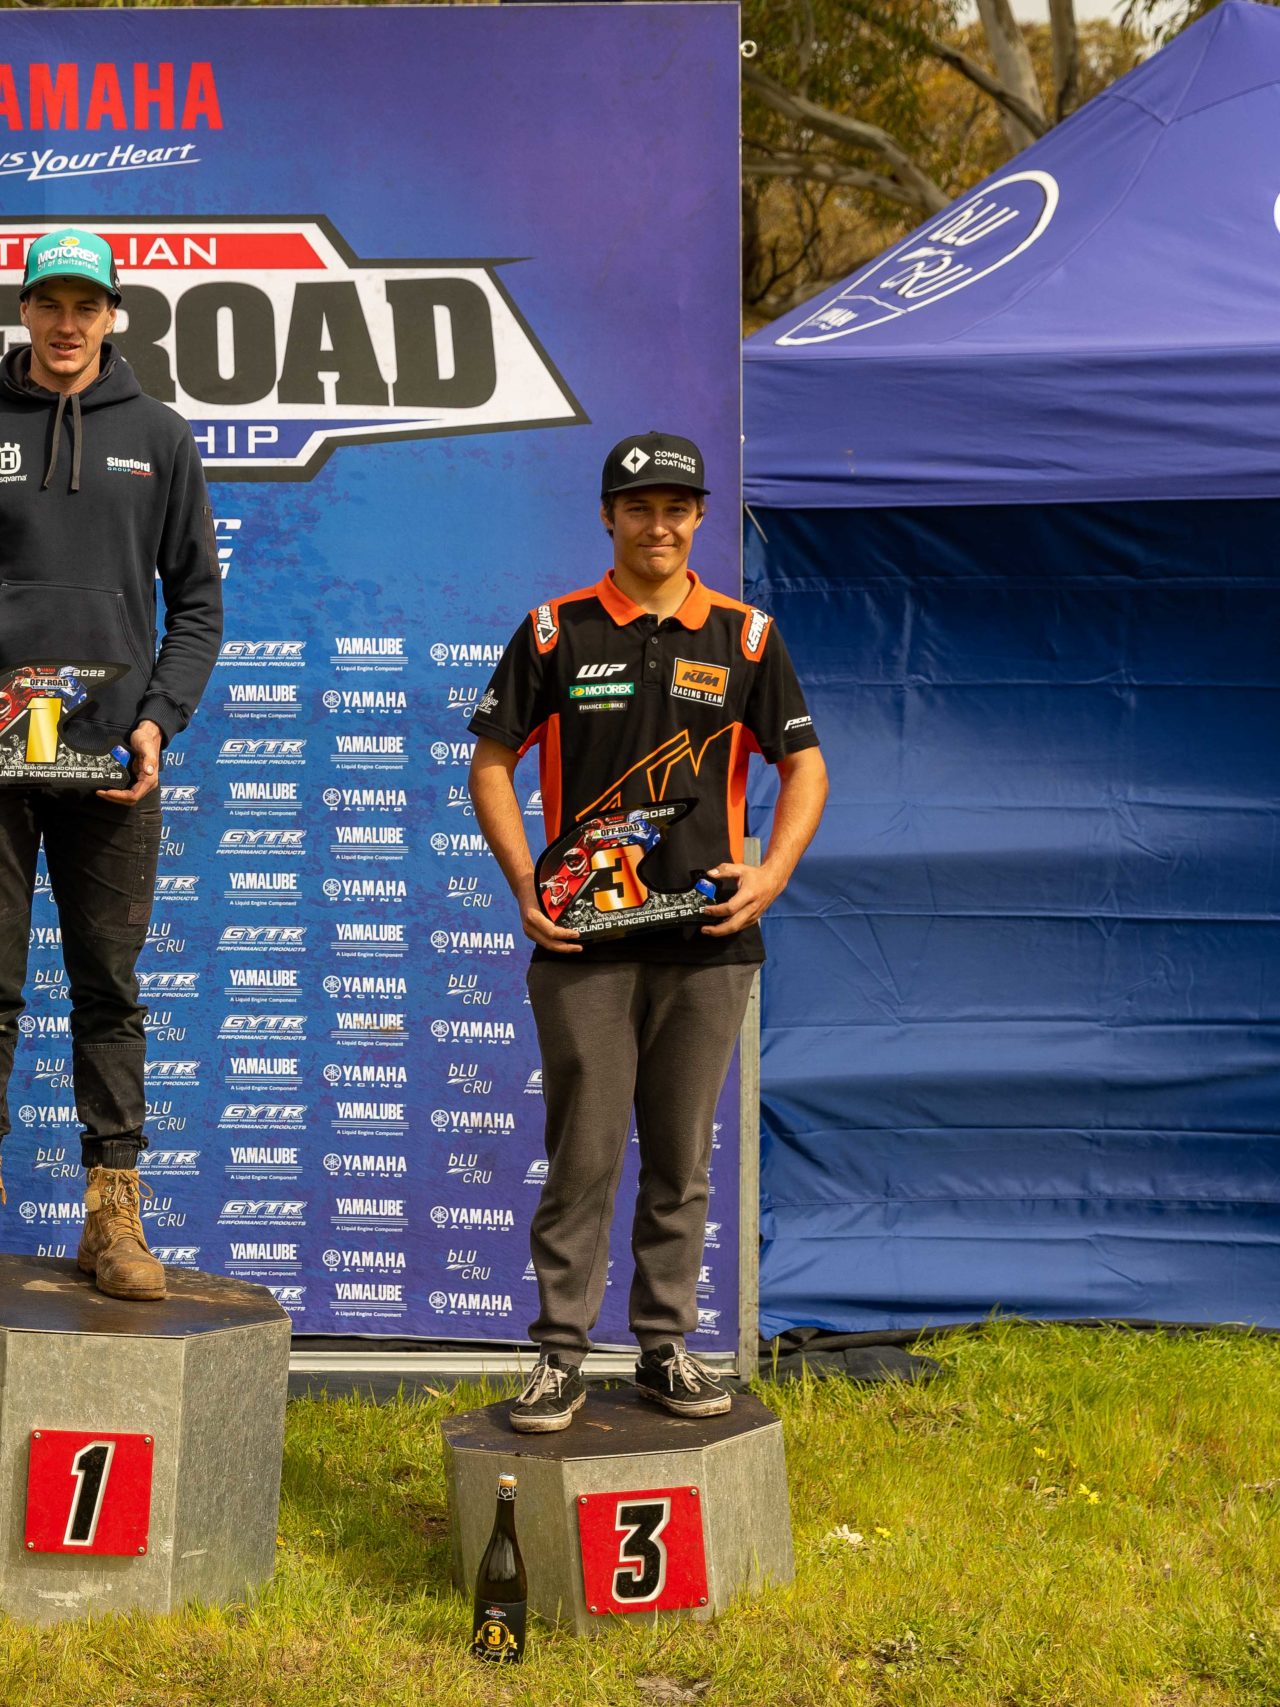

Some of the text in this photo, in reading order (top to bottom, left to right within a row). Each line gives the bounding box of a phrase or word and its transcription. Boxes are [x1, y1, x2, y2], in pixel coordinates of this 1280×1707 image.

[27, 149, 108, 181] Your
[107, 143, 197, 167] Heart
[38, 247, 99, 266] MOTOREX
[58, 259, 99, 273] Switzerland
[107, 457, 151, 472] Simford
[654, 450, 696, 466] COMPLETE
[654, 459, 696, 474] COATINGS
[336, 637, 403, 654] YAMALUBE
[73, 669, 106, 677] 2022
[576, 664, 627, 679] WP
[682, 670, 720, 687] KTM
[29, 679, 69, 687] OFF-ROAD
[585, 685, 632, 696] MOTOREX
[342, 691, 407, 707] YAMAHA
[673, 686, 723, 704] RACING TEAM
[25, 698, 63, 764] 1
[222, 739, 306, 754] GYTR
[230, 782, 296, 799] YAMALUBE
[642, 807, 675, 819] 2022
[600, 824, 640, 837] OFF-ROAD
[591, 844, 649, 912] 3
[342, 879, 407, 896] YAMAHA
[618, 914, 663, 927] KINGSTON
[680, 907, 693, 917] SA
[337, 923, 403, 941] YAMALUBE
[450, 932, 514, 948] YAMAHA
[231, 1147, 297, 1164] YAMALUBE
[343, 1155, 407, 1171] YAMAHA
[337, 1197, 403, 1216] YAMALUBE
[448, 1292, 512, 1310] YAMAHA
[63, 1440, 116, 1547] 1
[611, 1497, 672, 1604] 3
[488, 1625, 501, 1645] 3
